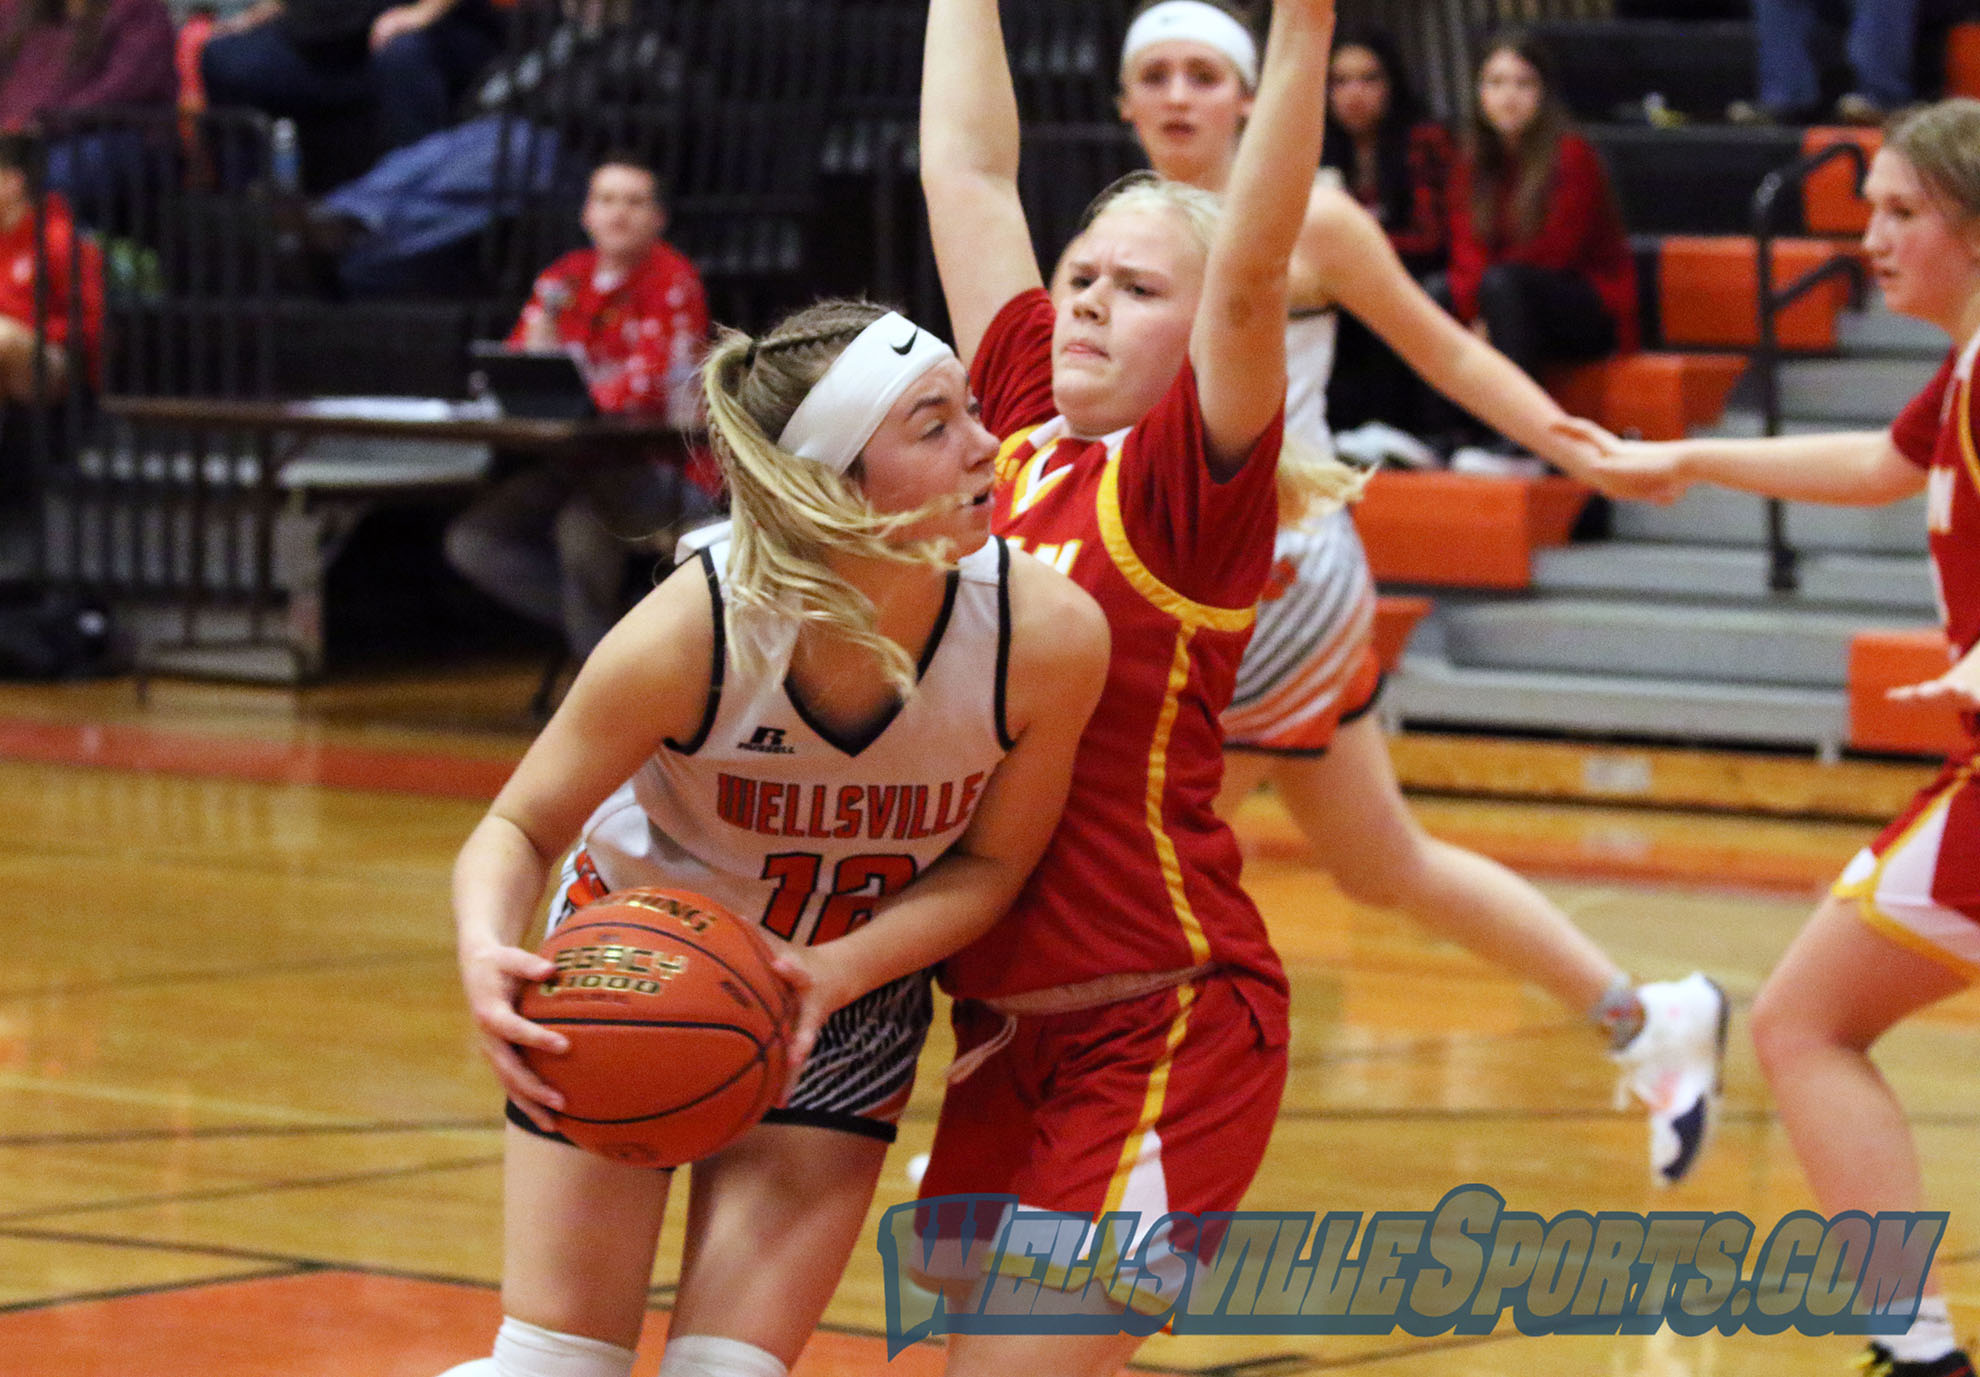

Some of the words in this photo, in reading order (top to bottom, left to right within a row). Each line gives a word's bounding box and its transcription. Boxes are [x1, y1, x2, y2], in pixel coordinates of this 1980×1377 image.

[717, 771, 984, 840] WELLSVILLE
[760, 852, 917, 947] 12
[541, 973, 661, 996] 1000
[555, 943, 689, 980] EGACY
